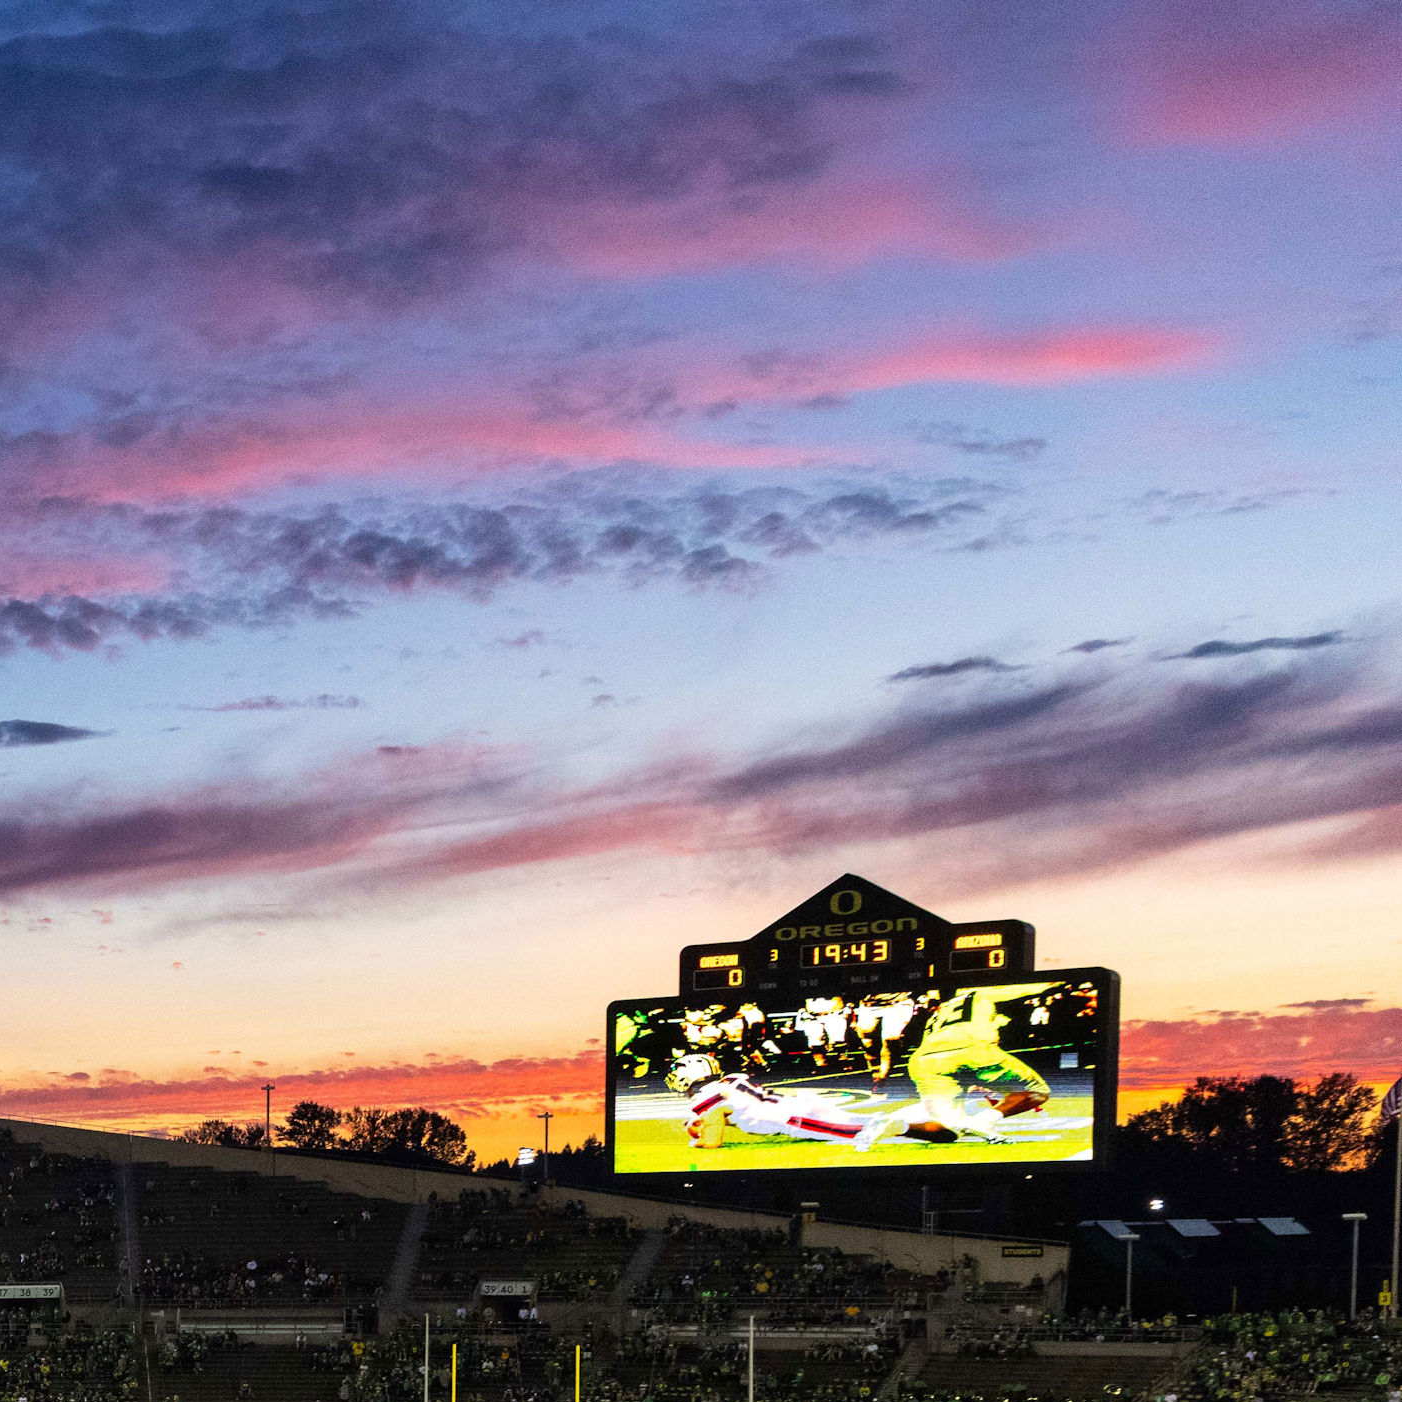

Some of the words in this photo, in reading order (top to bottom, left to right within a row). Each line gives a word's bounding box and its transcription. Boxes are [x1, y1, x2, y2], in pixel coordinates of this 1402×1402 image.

[830, 890, 862, 915] O
[775, 917, 918, 941] OREGON
[915, 937, 925, 951] 3
[769, 949, 778, 962] 3
[813, 940, 889, 965] 19:43
[989, 949, 1005, 968] 0
[728, 969, 743, 986] 0
[928, 964, 935, 978] 1
[19, 1288, 31, 1297] 38
[42, 1287, 55, 1297] 39
[484, 1284, 497, 1294] 39
[501, 1284, 514, 1294] 40
